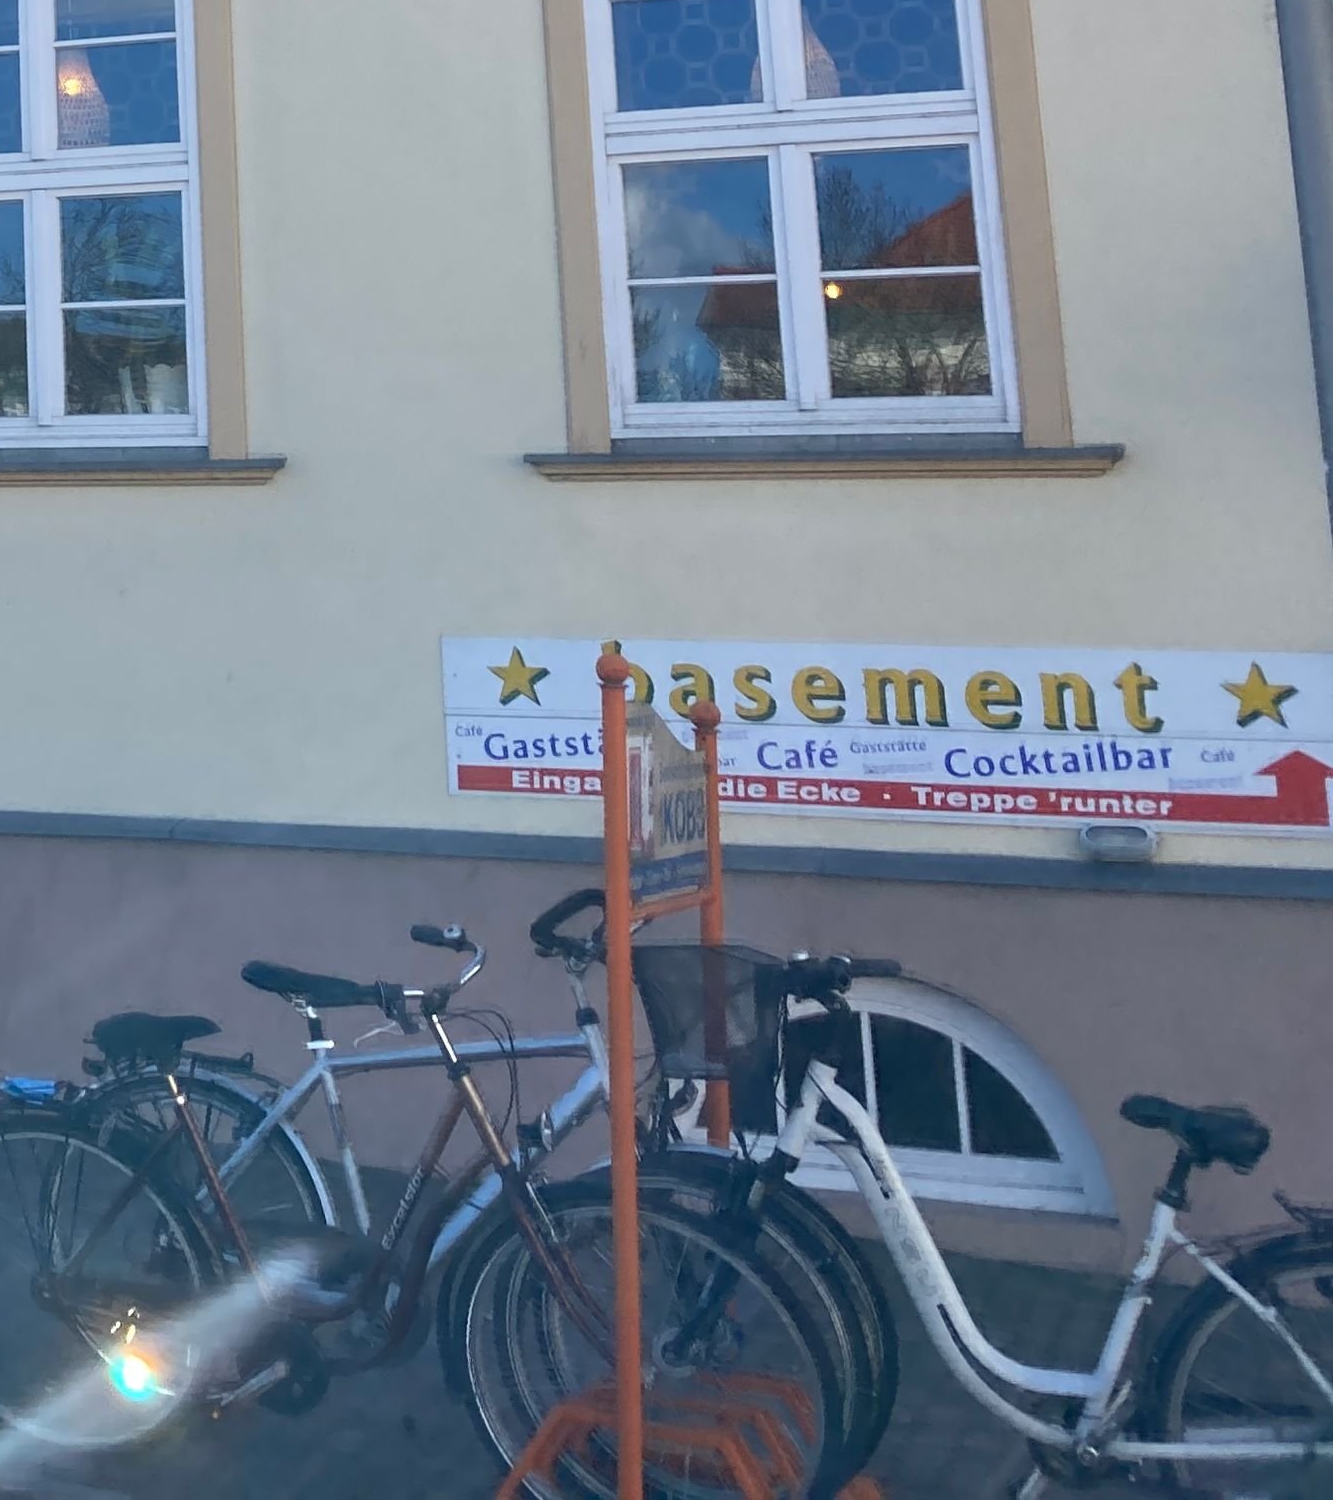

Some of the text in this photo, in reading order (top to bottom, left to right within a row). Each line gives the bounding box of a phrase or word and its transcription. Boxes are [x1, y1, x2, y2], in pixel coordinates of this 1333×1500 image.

[757, 740, 838, 770] Café
[944, 741, 1173, 778] Cocktailbar
[849, 739, 927, 754] Gaststätte
[511, 769, 602, 795] Einga
[717, 778, 767, 799] die
[777, 780, 861, 803] Ecke
[910, 785, 1038, 813] Treppe
